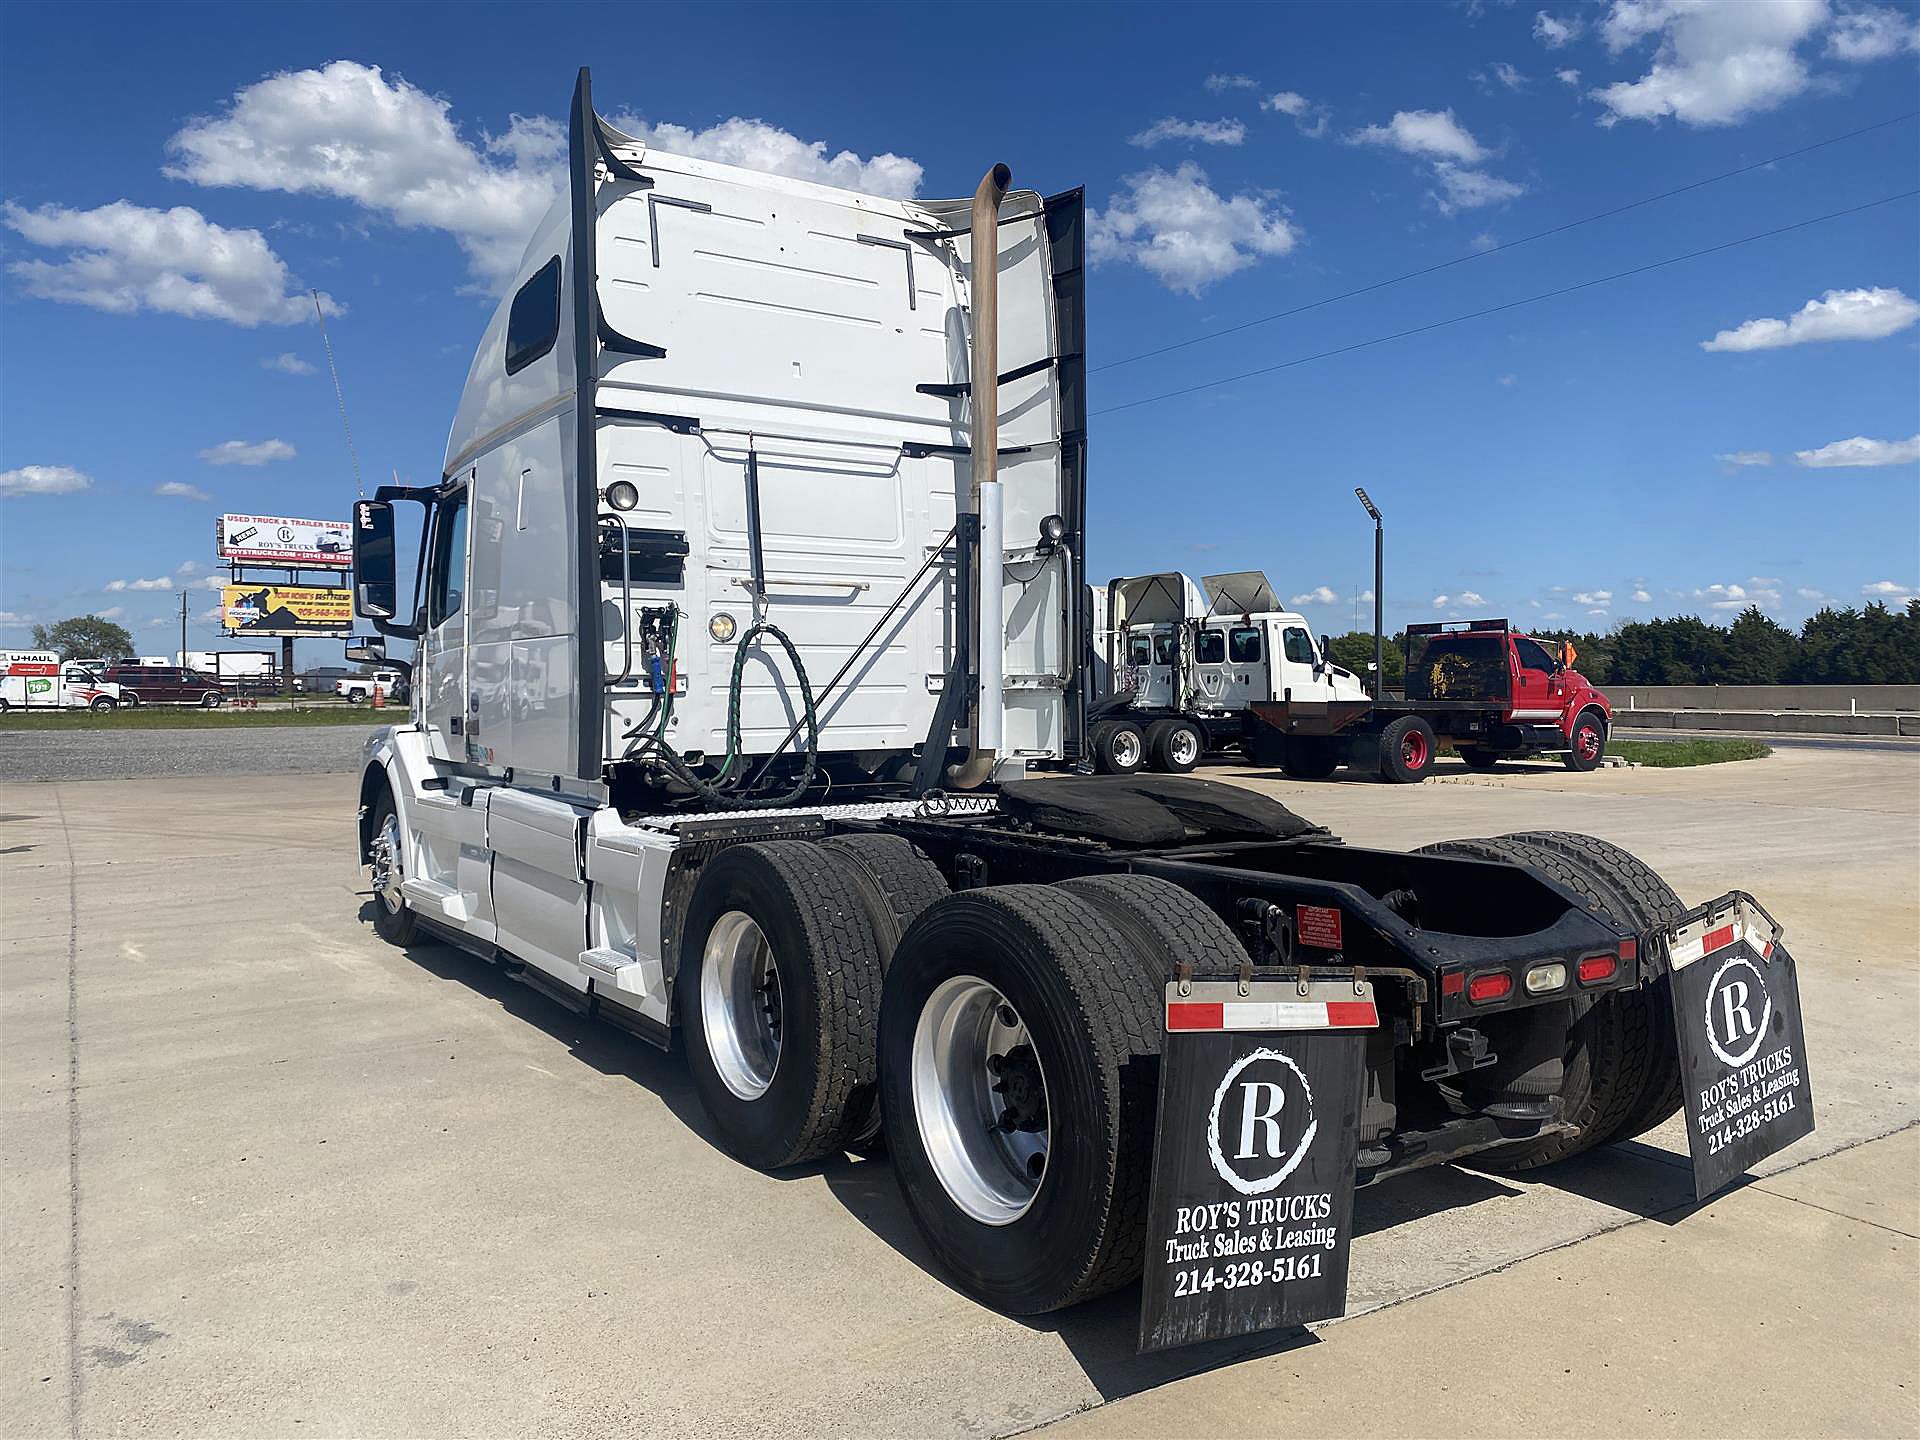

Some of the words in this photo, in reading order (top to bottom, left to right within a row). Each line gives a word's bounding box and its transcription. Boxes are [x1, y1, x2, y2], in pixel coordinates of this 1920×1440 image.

[227, 515, 250, 523] USED
[251, 517, 280, 525] TRUCK
[291, 519, 323, 527] TRAILER
[325, 522, 350, 530] SALES
[235, 527, 257, 542] HERE
[226, 548, 296, 557] ROYSTRUCKS.COM
[258, 541, 282, 549] ROY'S
[284, 543, 314, 551] TRUCKS
[1719, 980, 1757, 1046] R
[1700, 1073, 1739, 1112] ROY'S
[1740, 1045, 1792, 1088] TRUCKS
[1233, 1082, 1286, 1160] R
[1698, 1105, 1726, 1134] Truck
[1725, 1093, 1752, 1119] Sales
[1752, 1085, 1762, 1104] &
[1760, 1068, 1800, 1099] Leasing
[1708, 1091, 1796, 1156] 214-328-5161
[1174, 1201, 1241, 1235] ROY'S
[1246, 1193, 1332, 1226] TRUCKS
[1165, 1234, 1210, 1264] Truck
[1213, 1229, 1257, 1258] Sales
[1259, 1227, 1273, 1252] &
[1275, 1221, 1337, 1250] Leasing
[1174, 1253, 1322, 1298] 214-328-5161
